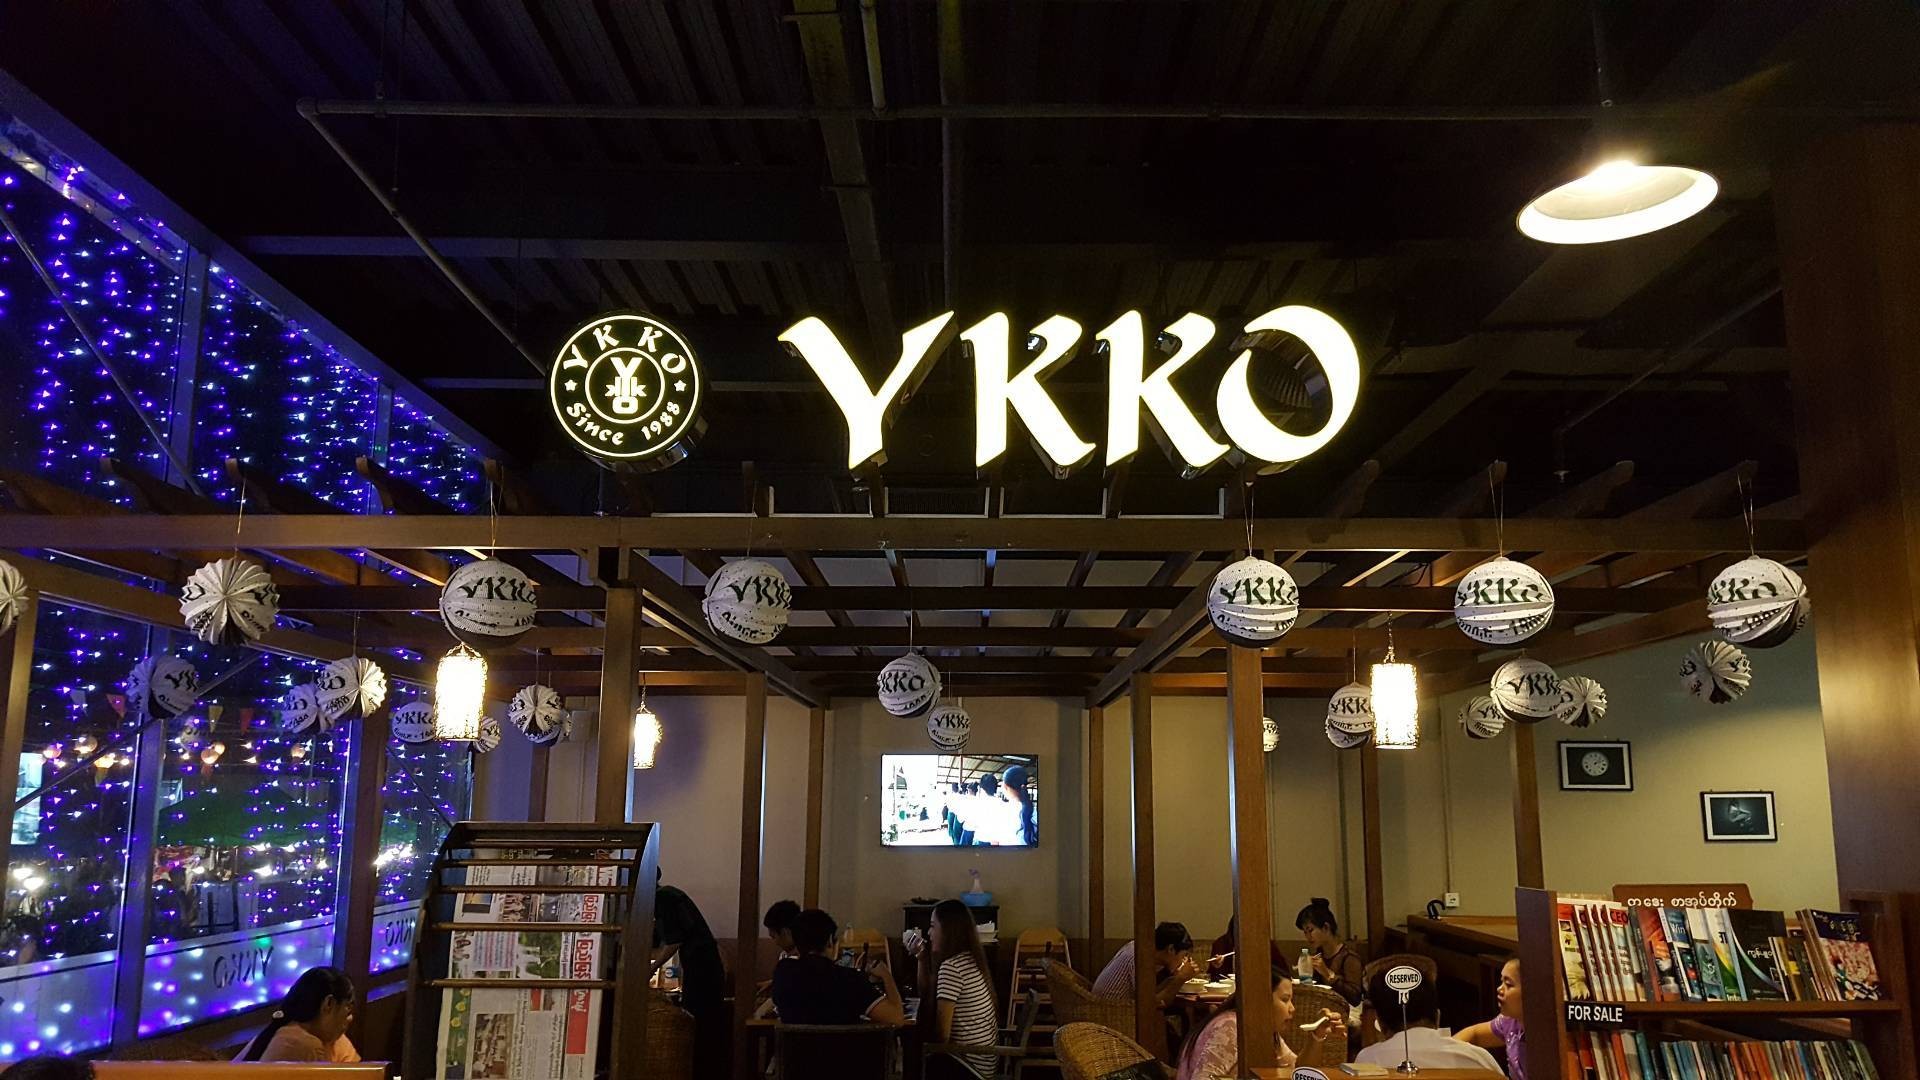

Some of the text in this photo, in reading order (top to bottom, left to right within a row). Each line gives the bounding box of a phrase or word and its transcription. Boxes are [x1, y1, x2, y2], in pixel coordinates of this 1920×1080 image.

[562, 324, 687, 374] YKKO
[778, 304, 1361, 470] YKKO
[566, 401, 680, 446] Since 1988
[1330, 697, 1373, 715] YKK
[1389, 973, 1419, 984] RESERVED
[1568, 1004, 1623, 1022] FOR SALE
